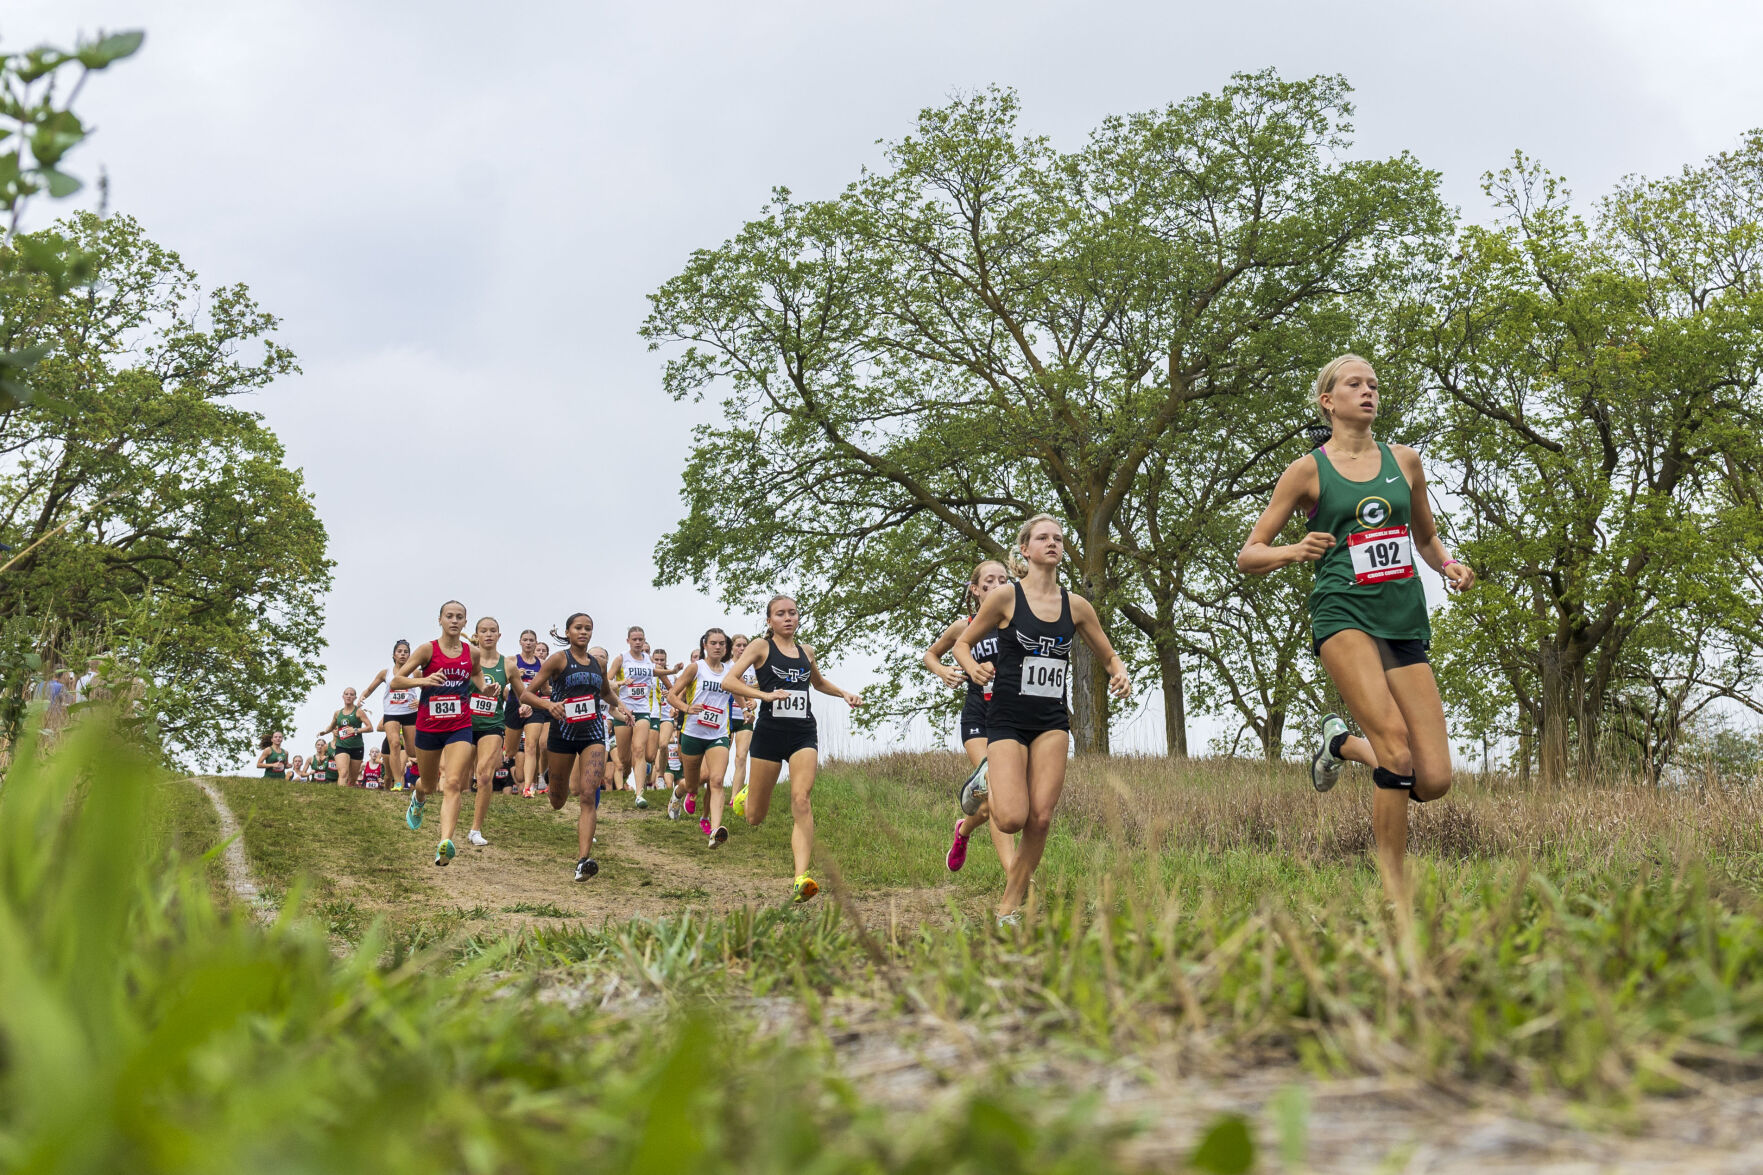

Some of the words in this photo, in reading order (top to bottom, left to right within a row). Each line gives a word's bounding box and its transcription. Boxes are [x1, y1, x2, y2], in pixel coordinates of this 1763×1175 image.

[1363, 503, 1384, 523] G
[1365, 541, 1401, 568] 192
[628, 668, 647, 677] PIUS
[1027, 665, 1062, 688] 1046
[435, 702, 455, 714] 834
[476, 700, 492, 710] 199
[575, 702, 588, 714] 44
[776, 696, 805, 711] 1043
[704, 711, 719, 723] 521
